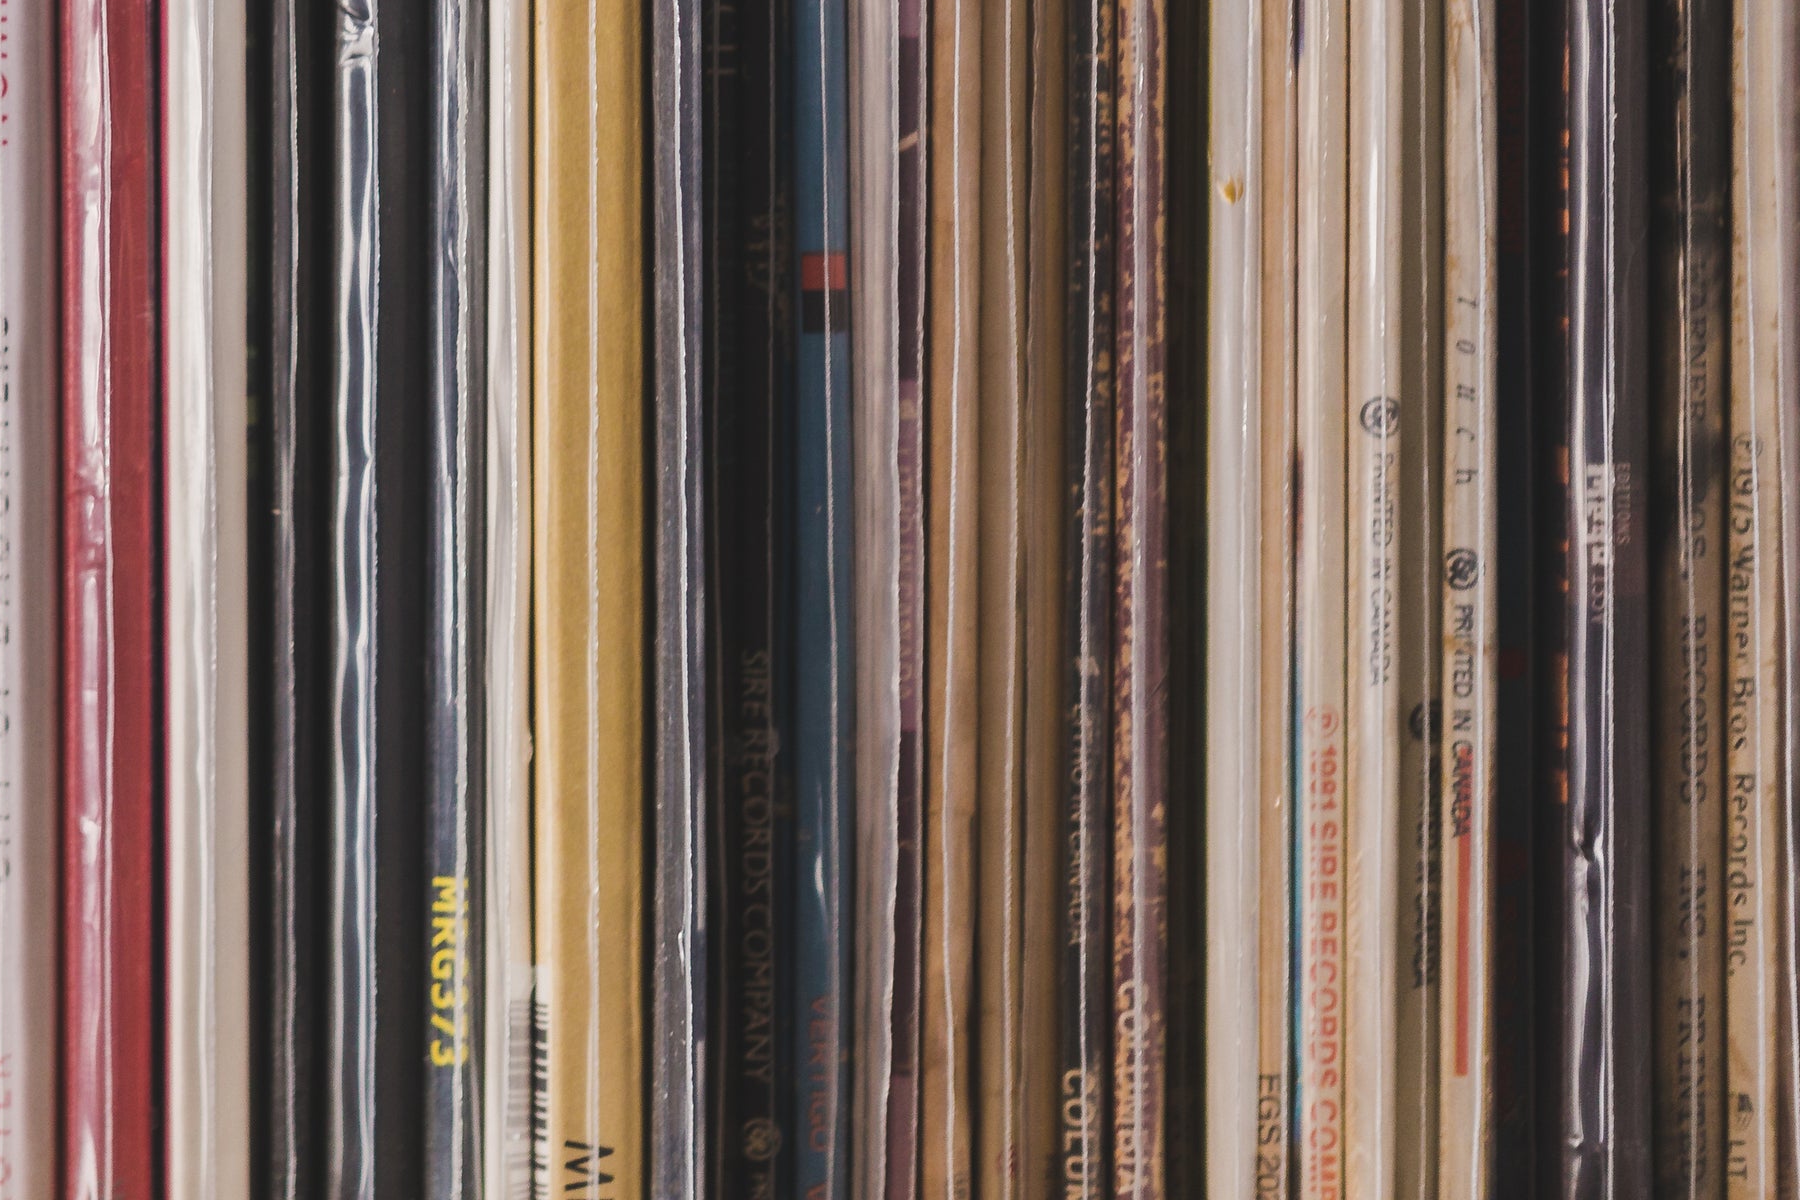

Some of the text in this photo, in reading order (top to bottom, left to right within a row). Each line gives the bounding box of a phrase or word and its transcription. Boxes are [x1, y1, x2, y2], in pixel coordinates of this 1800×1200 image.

[1369, 451, 1395, 685] PRINTED CANADA
[1614, 462, 1631, 547] EDITIONS
[1730, 466, 1759, 534] 1975
[1730, 544, 1756, 662] Warner
[1450, 602, 1474, 840] PRINTED IN CANADA
[740, 648, 771, 1086] SIRE RECORDS COMPANY
[1308, 743, 1337, 1089] 1981 SIRE RECORDS
[1676, 612, 1706, 1192] RECORDS INC. PRINTED
[1728, 768, 1757, 907] Records
[430, 875, 467, 1067] MRG373
[806, 995, 832, 1152] VERTIGO
[1115, 977, 1147, 1197] COLUMBIA
[1256, 1070, 1282, 1145] EGS
